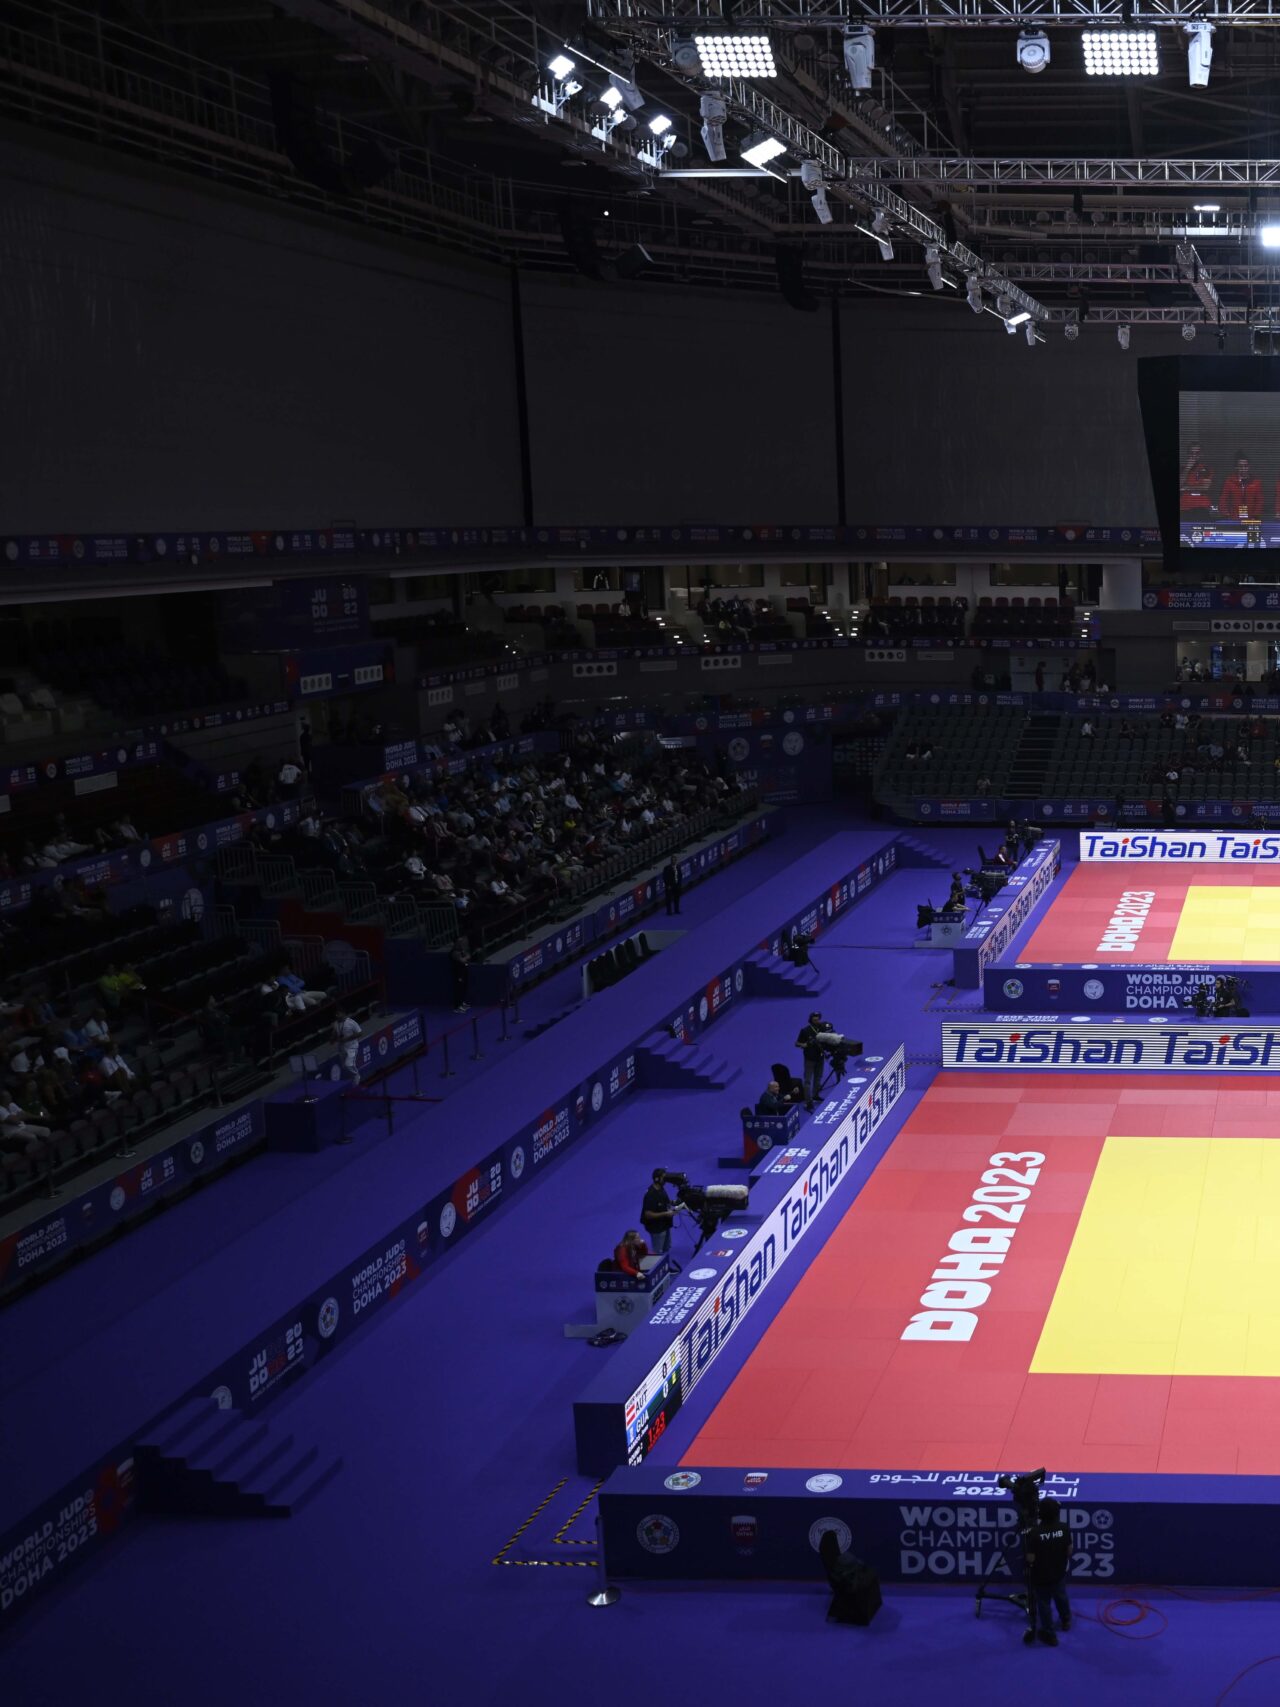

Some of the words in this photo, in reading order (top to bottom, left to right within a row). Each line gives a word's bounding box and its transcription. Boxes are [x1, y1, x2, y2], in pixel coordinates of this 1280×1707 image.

[1085, 835, 1207, 858] TaiShan
[1113, 891, 1156, 916] 2023
[1096, 916, 1146, 952] DOHA
[1126, 974, 1182, 985] WORLD
[1126, 995, 1178, 1008] DOHA
[950, 1029, 1144, 1064] TaiShan
[533, 1139, 554, 1164] DOHA
[553, 1125, 570, 1147] 2023
[962, 1151, 1046, 1223] 2023
[682, 1233, 776, 1386] TaiShan
[780, 1135, 849, 1252] TaiShan
[851, 1061, 905, 1152] TaiShan
[17, 1246, 45, 1268] DOHA
[46, 1232, 68, 1251] 2023
[351, 1257, 383, 1289] WORLD
[384, 1238, 406, 1264] JUDO
[353, 1283, 383, 1315] DOHA
[384, 1260, 407, 1290] 2023
[900, 1227, 1017, 1342] DOHA
[635, 1389, 648, 1413] AUT
[953, 1486, 1006, 1496] 2023
[0, 1520, 54, 1574] WORLD
[56, 1488, 95, 1528] JUDO
[899, 1506, 1019, 1527] WORLD
[900, 1530, 1115, 1550] CHAMPIOIPS
[1040, 1533, 1051, 1541] TV
[1052, 1529, 1064, 1539] HB
[0, 1555, 54, 1611] DOHA
[57, 1516, 98, 1563] 2023
[901, 1550, 1012, 1576] DOHA
